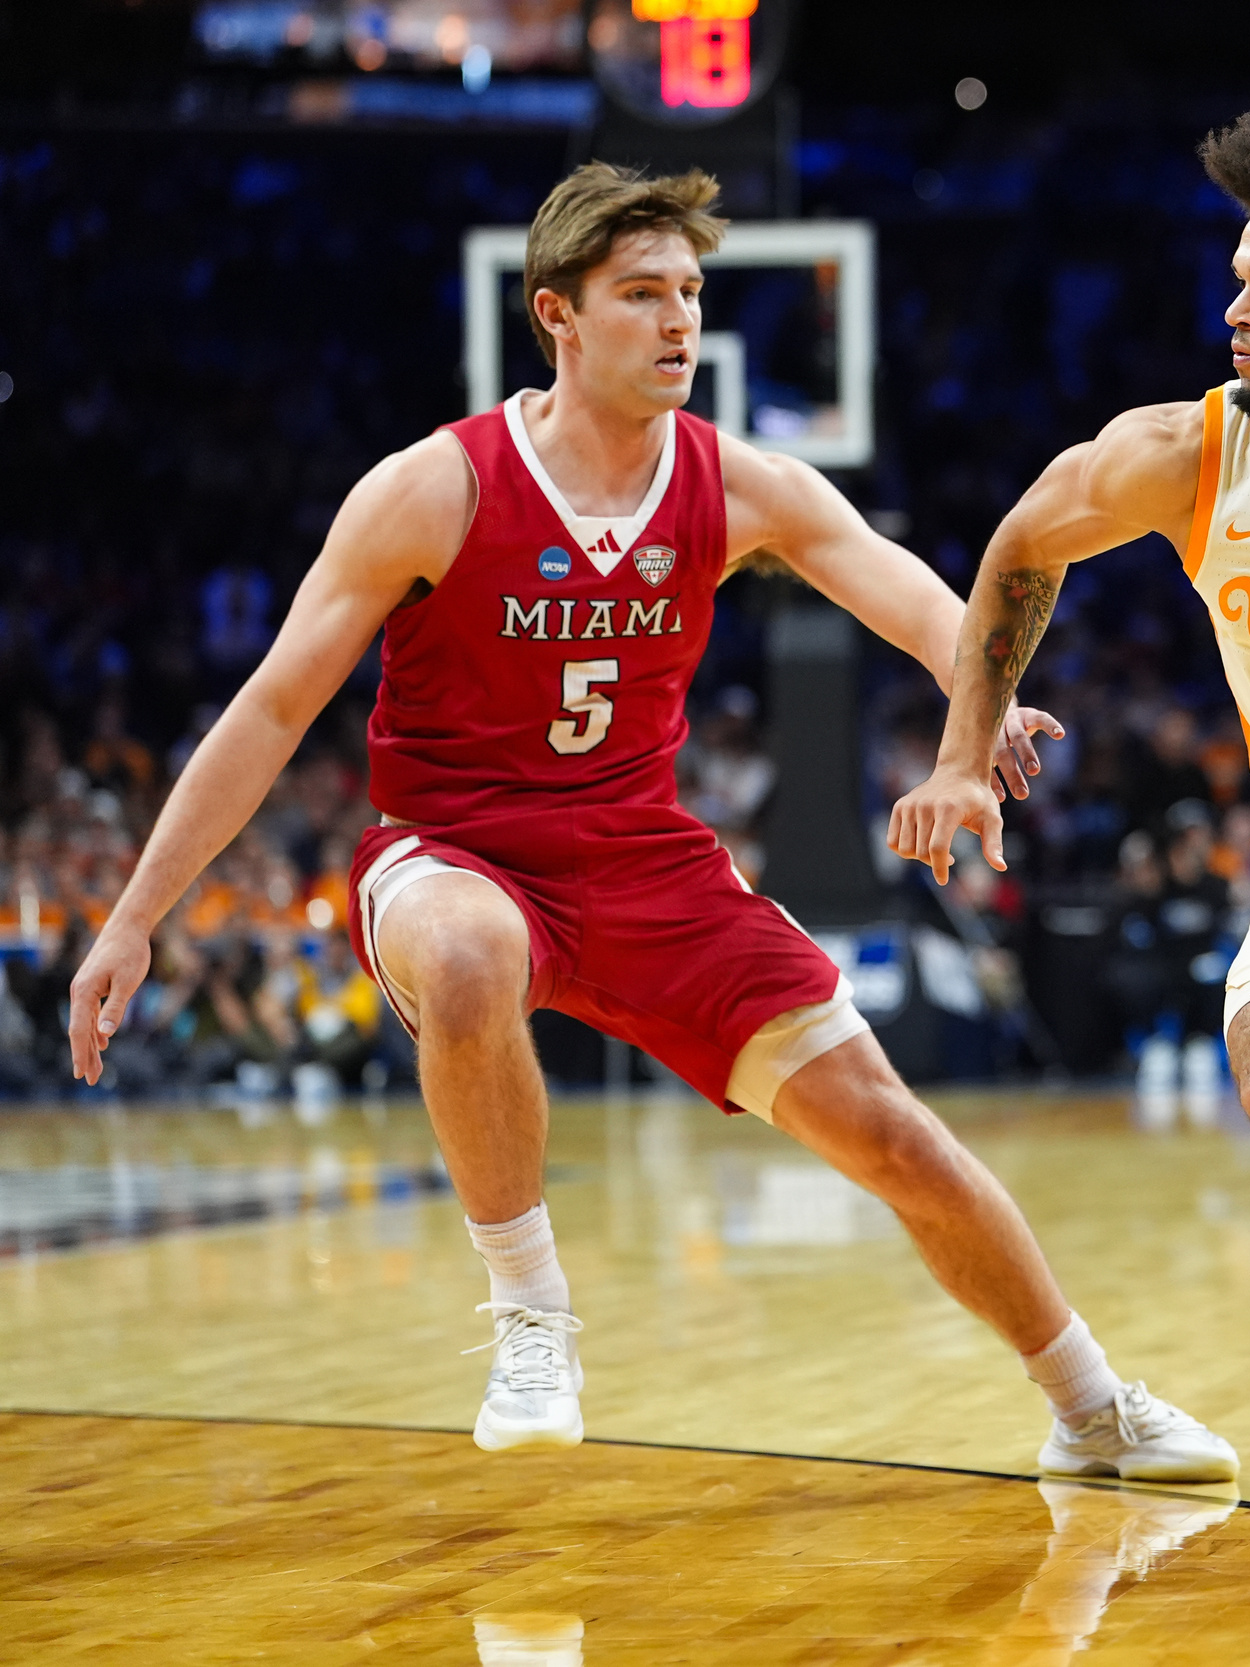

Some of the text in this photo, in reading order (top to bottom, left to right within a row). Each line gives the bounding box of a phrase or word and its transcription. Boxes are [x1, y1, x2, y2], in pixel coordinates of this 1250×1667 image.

[541, 561, 569, 574] NCAA
[637, 559, 672, 570] MAC
[546, 657, 620, 757] 5
